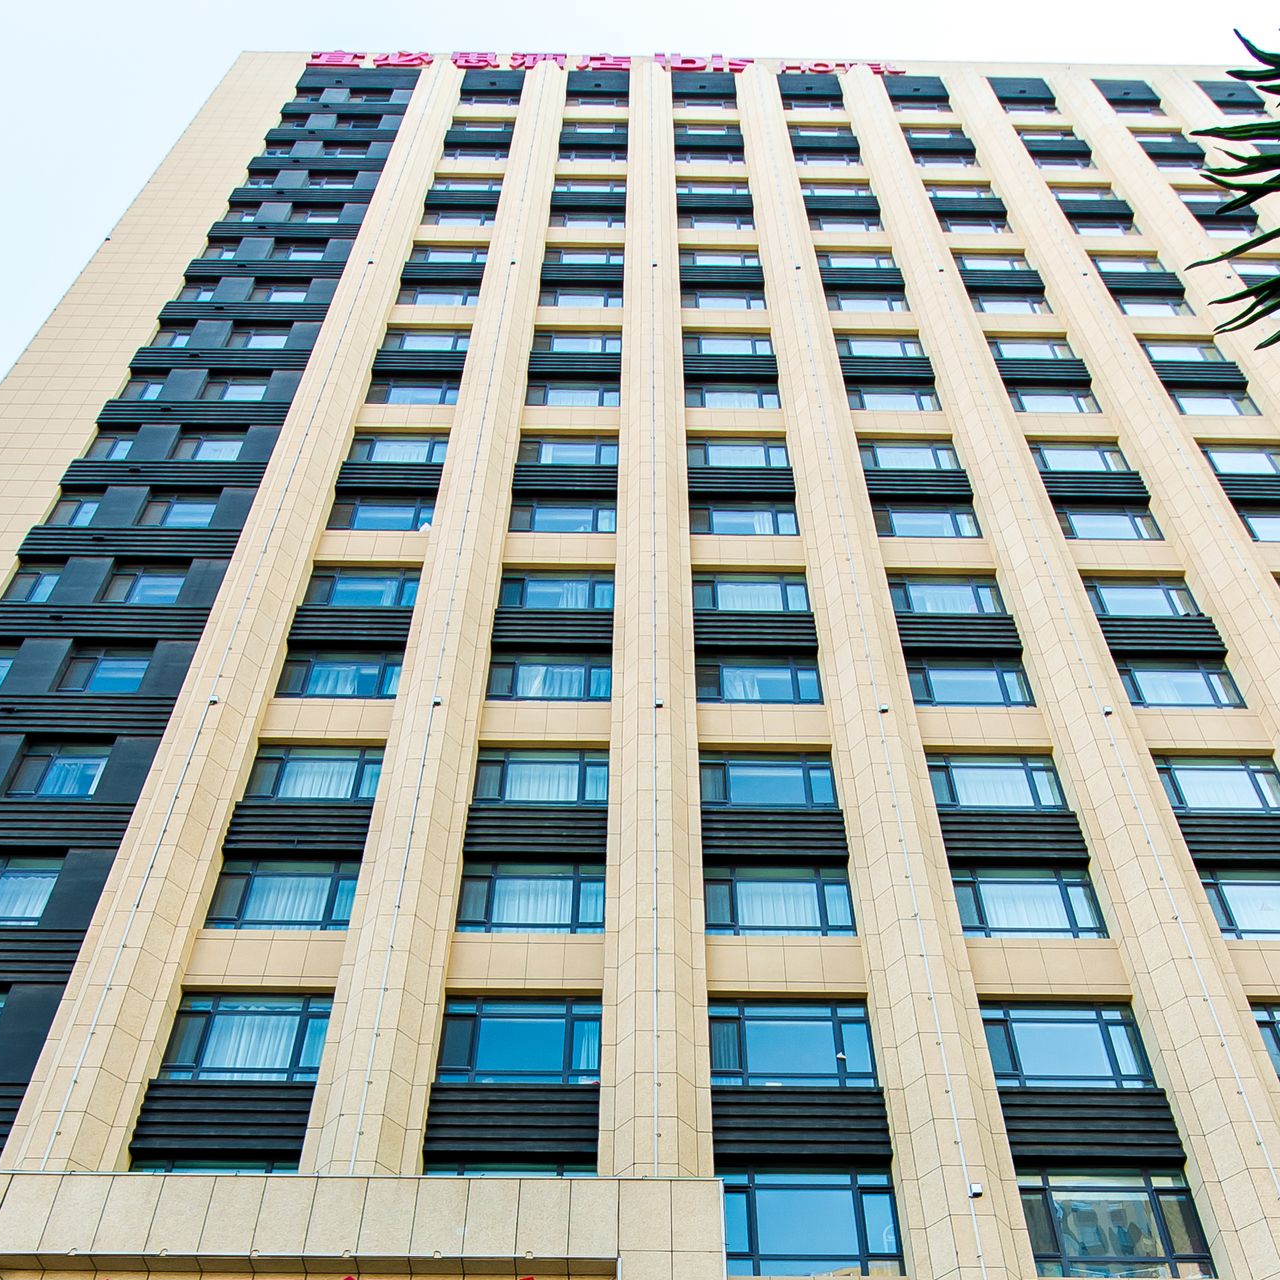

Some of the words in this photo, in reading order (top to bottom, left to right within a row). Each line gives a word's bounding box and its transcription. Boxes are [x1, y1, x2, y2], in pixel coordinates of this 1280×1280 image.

[305, 50, 632, 71] 宜必思酒店
[654, 53, 755, 73] ibis
